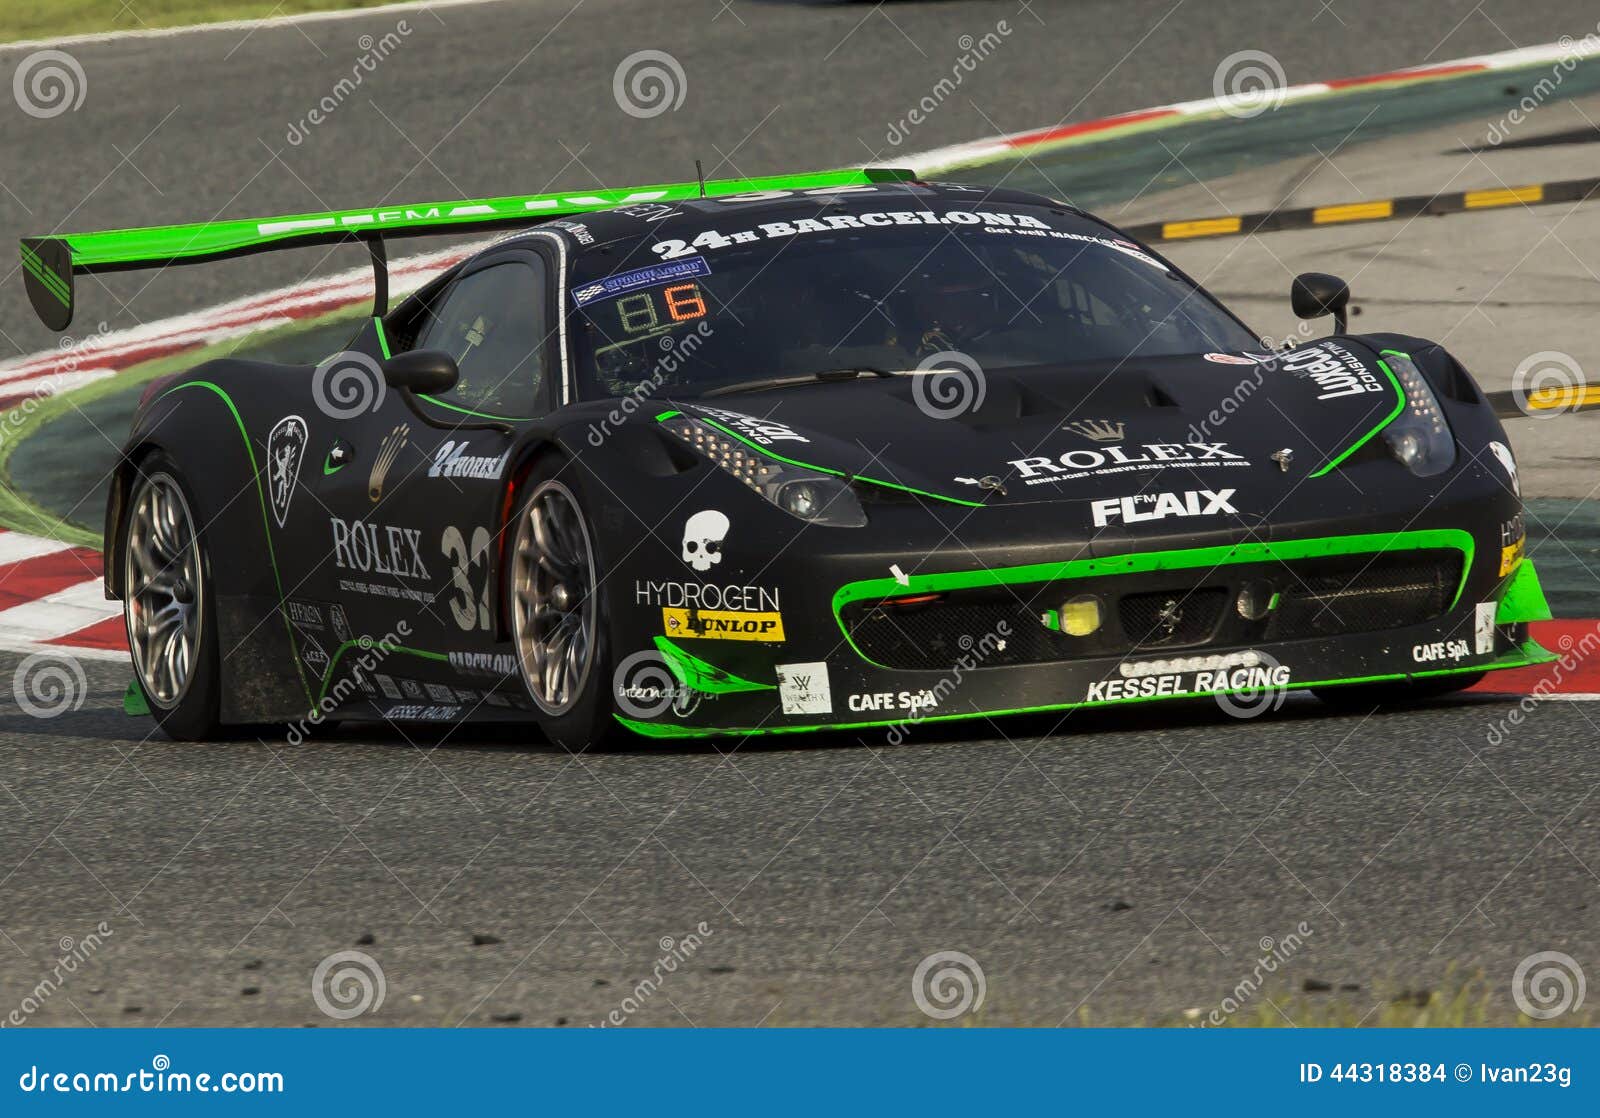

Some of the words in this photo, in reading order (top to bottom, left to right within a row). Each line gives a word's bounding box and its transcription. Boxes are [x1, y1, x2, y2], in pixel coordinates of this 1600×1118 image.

[757, 210, 1052, 238] BARCELONA
[1007, 442, 1245, 478] ROLEX
[1090, 488, 1240, 527] FLAIX
[330, 517, 432, 580] ROLEX
[636, 579, 780, 611] HYDROGEN
[1413, 644, 1446, 662] CAFE
[1087, 674, 1188, 701] KESSEL
[1194, 665, 1291, 692] RACING
[848, 693, 895, 712] CAFE
